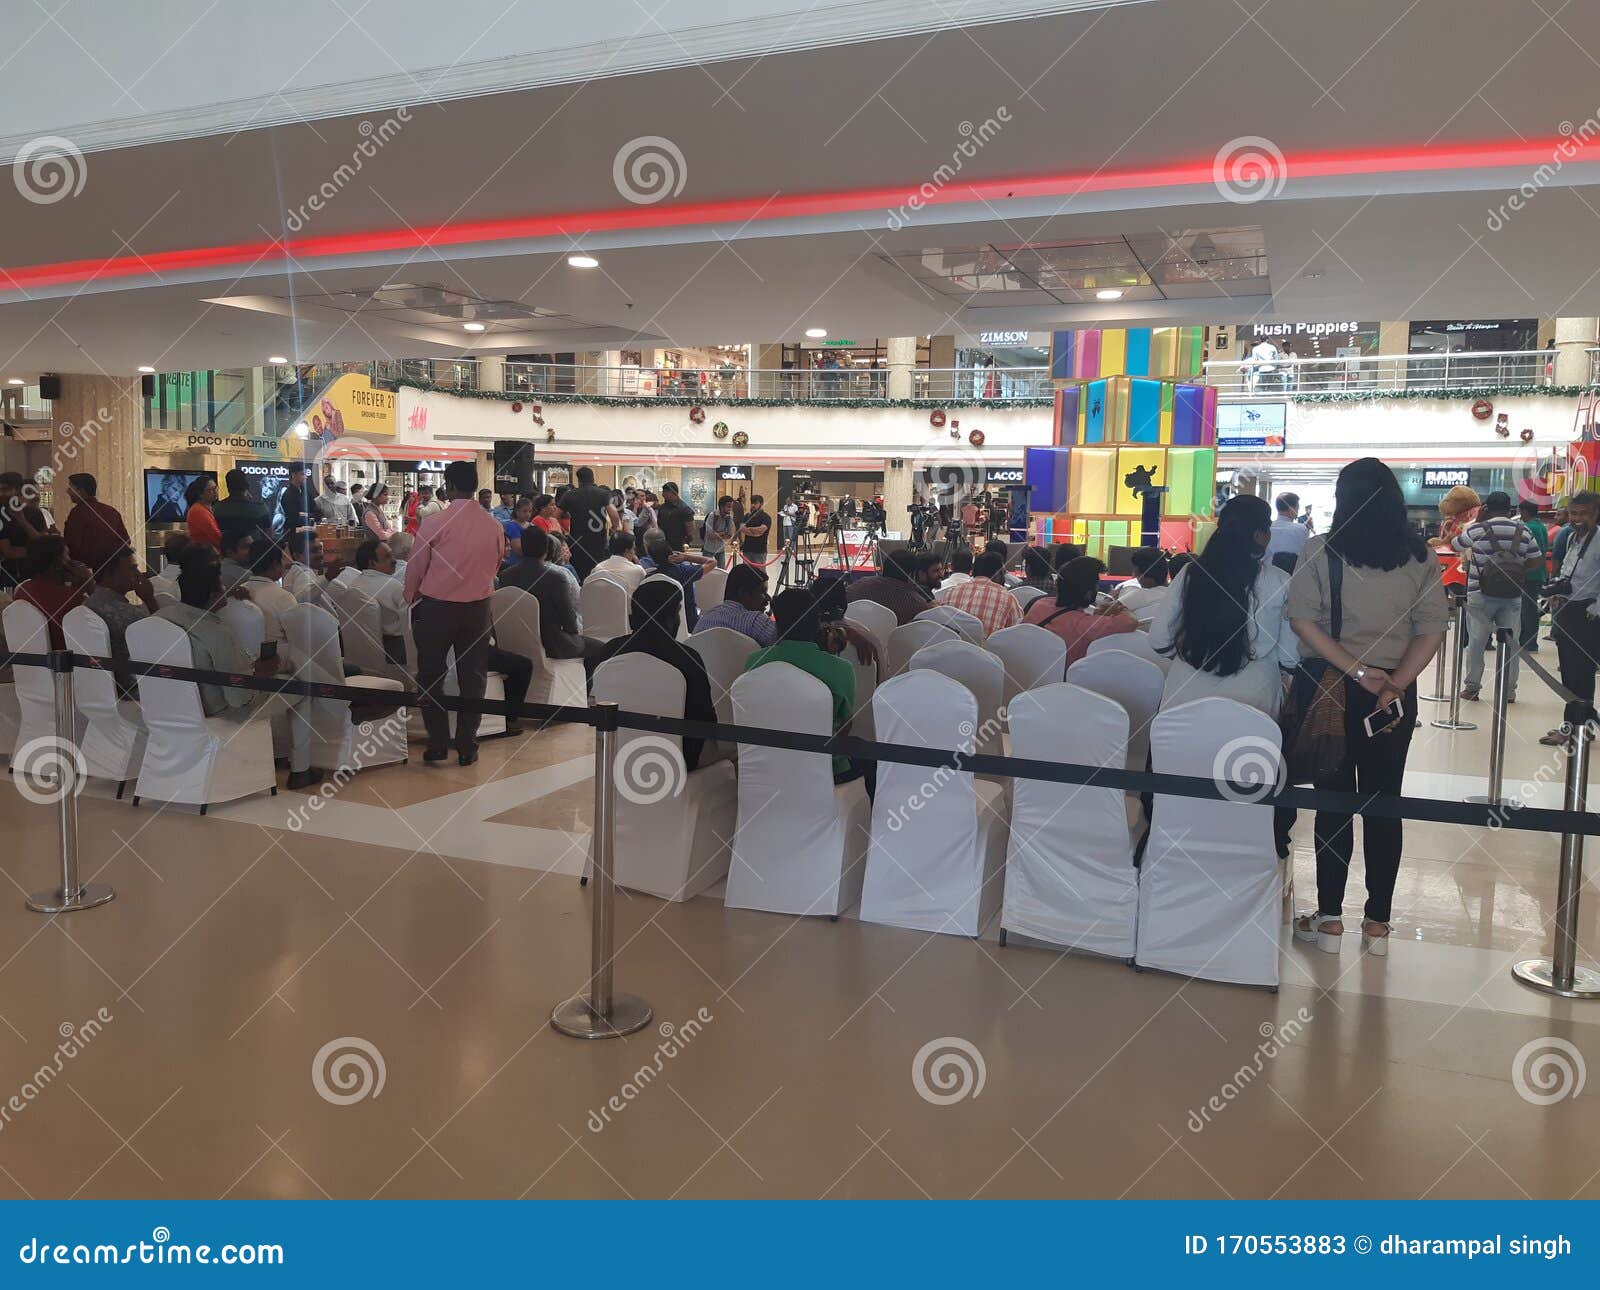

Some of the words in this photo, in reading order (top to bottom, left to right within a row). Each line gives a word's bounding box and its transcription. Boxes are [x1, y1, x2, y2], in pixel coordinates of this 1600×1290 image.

[1253, 323, 1291, 336] Hush
[1295, 321, 1358, 336] Puppies
[980, 331, 1028, 342] ZIMSON
[352, 389, 385, 408] FOREVER
[388, 394, 395, 409] 21
[188, 435, 222, 446] paco
[225, 436, 278, 449] rabanne
[270, 466, 312, 477] rabe
[987, 471, 1023, 481] LACOS
[1425, 471, 1469, 481] RADO
